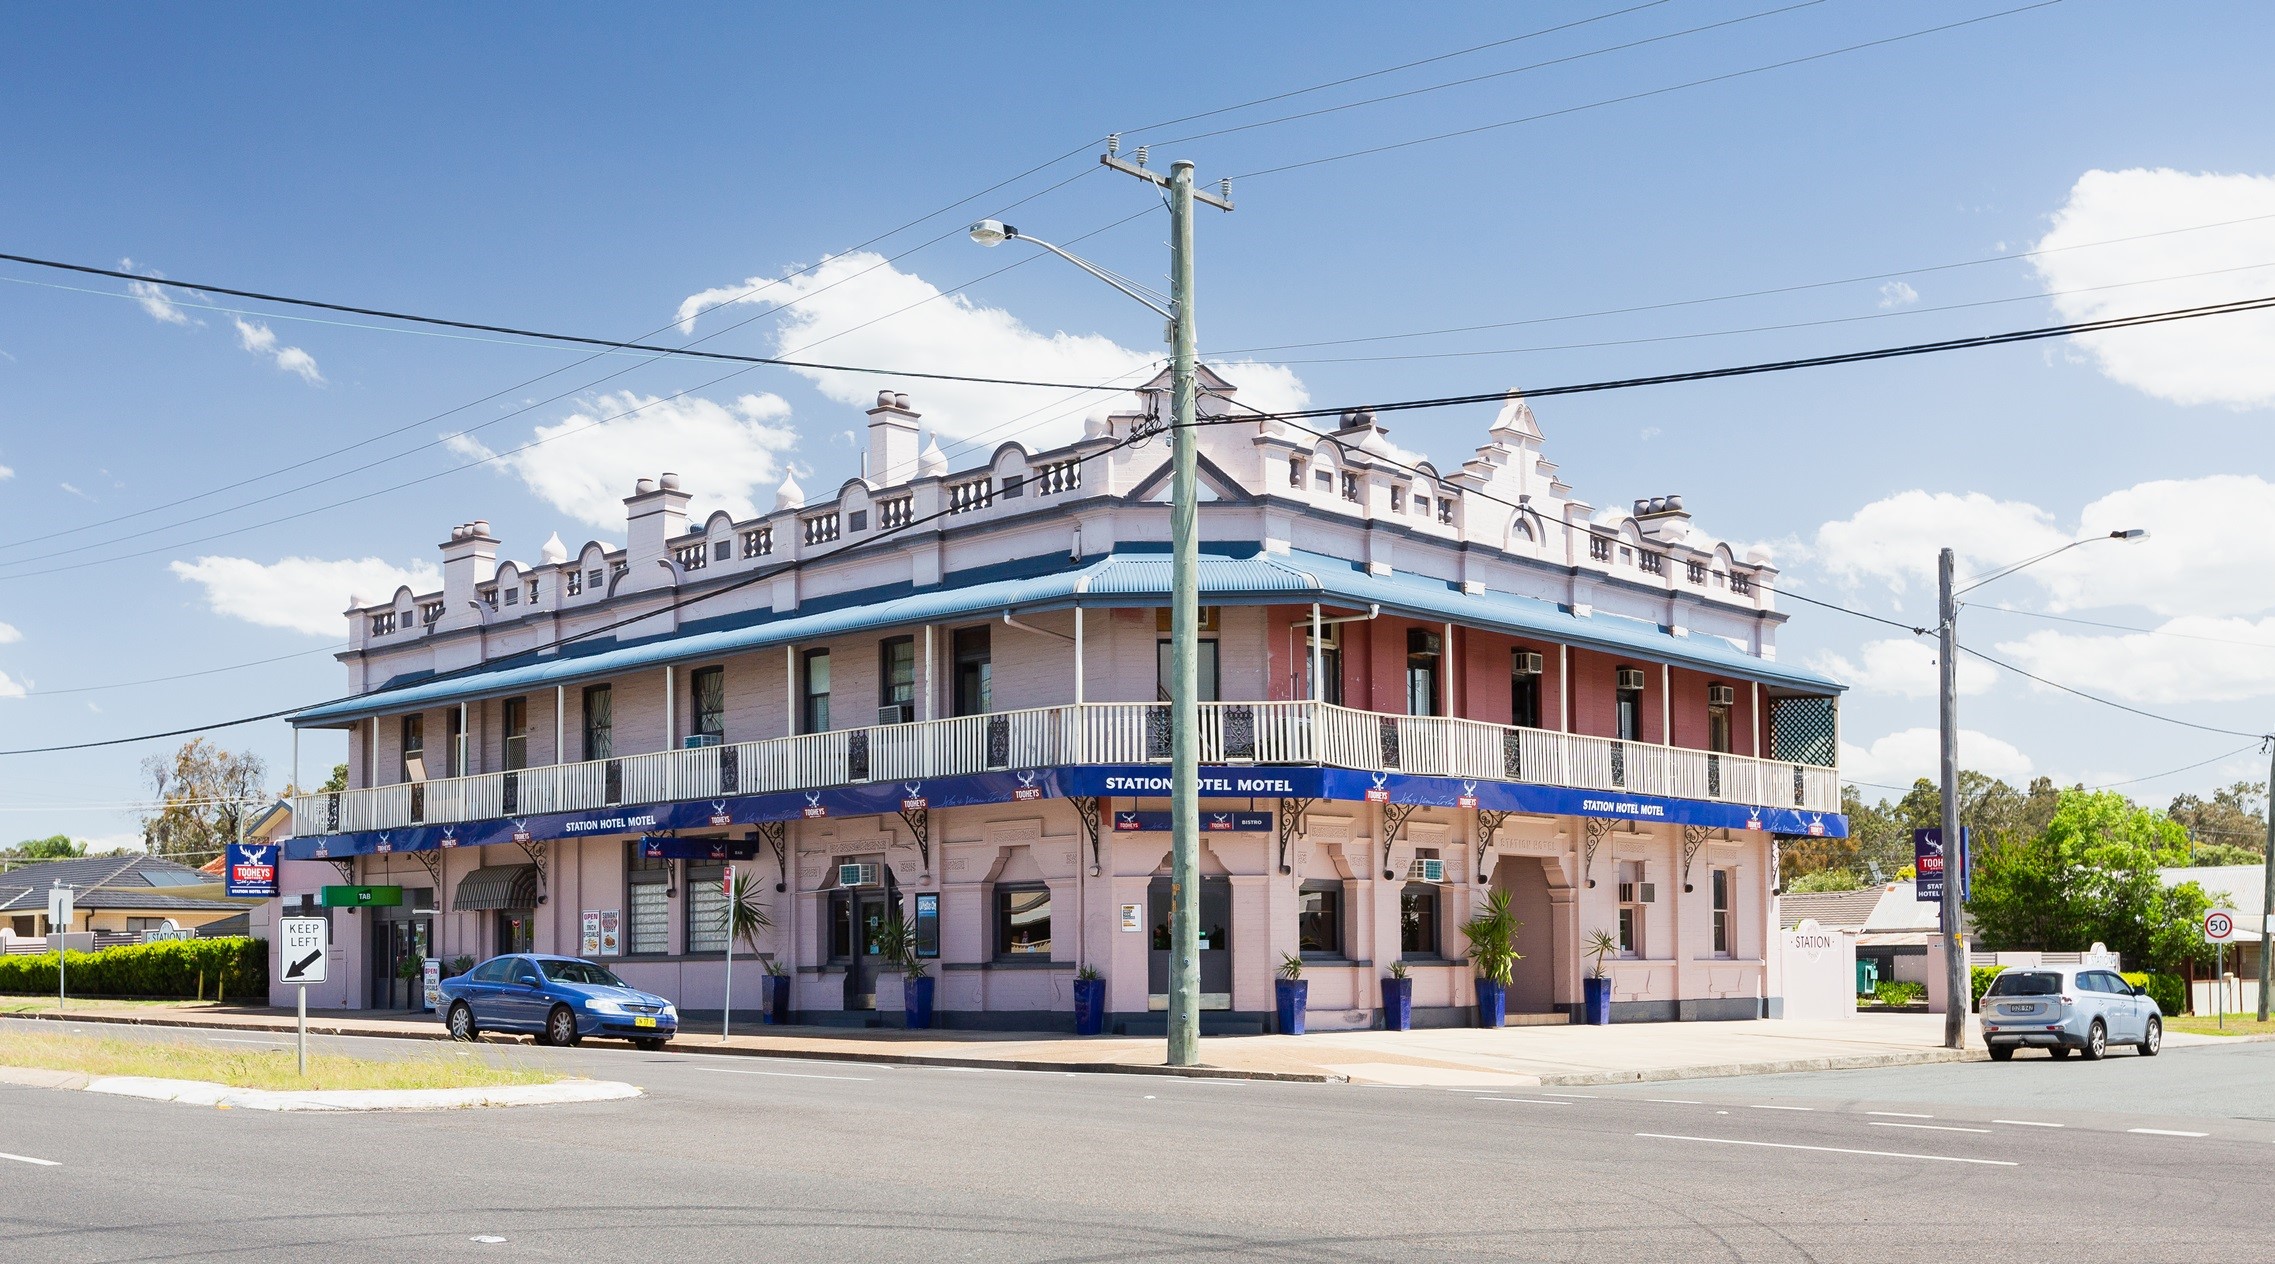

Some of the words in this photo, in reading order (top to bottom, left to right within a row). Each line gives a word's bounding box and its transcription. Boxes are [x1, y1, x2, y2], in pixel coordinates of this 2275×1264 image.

[1106, 777, 1172, 790] STATION
[1198, 778, 1232, 791] OTEL
[1237, 779, 1293, 792] MOTEL
[1015, 788, 1040, 798] TOOHEYS
[1367, 790, 1388, 799] TOOHEYS
[904, 799, 926, 807] TOOHEYS
[1583, 799, 1614, 812] STATION
[1615, 802, 1639, 814] HOTEL
[1640, 804, 1665, 816] MOTEL
[804, 807, 825, 816] TOOHEYS
[565, 820, 598, 832] STATION
[600, 817, 626, 829] HOTEL
[628, 815, 657, 827] MOTEL
[711, 816, 731, 824] TOOHEYS
[1922, 858, 1943, 868] TOOH
[237, 867, 270, 877] TOOHEYS
[289, 924, 319, 934] KEEP
[2210, 920, 2228, 932] 50
[152, 932, 181, 941] STATION
[1795, 935, 1830, 948] STATION
[290, 937, 318, 947] LEFT
